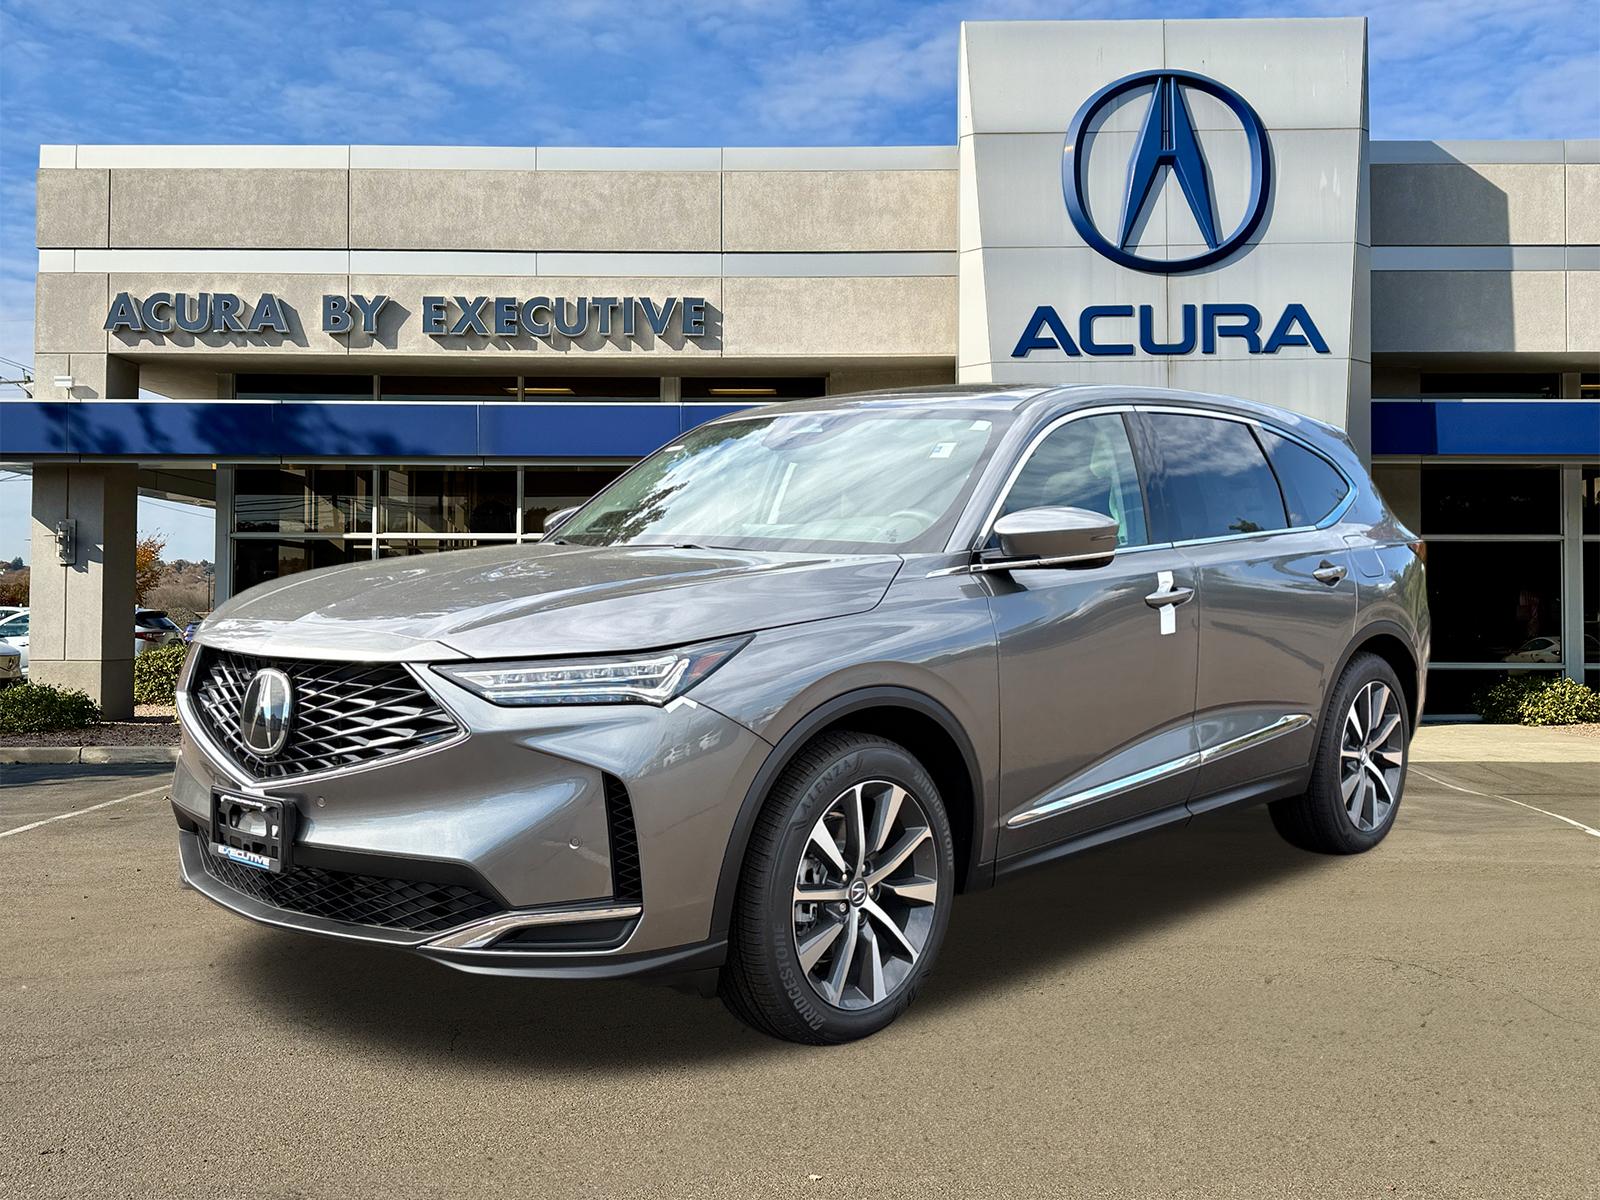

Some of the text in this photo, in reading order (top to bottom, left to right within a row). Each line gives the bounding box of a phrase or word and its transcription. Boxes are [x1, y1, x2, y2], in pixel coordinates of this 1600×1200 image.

[104, 291, 707, 337] ACURA BY EXECUTIVE
[1011, 303, 1332, 357] ACURA
[773, 921, 827, 1031] BRIDGESTONE
